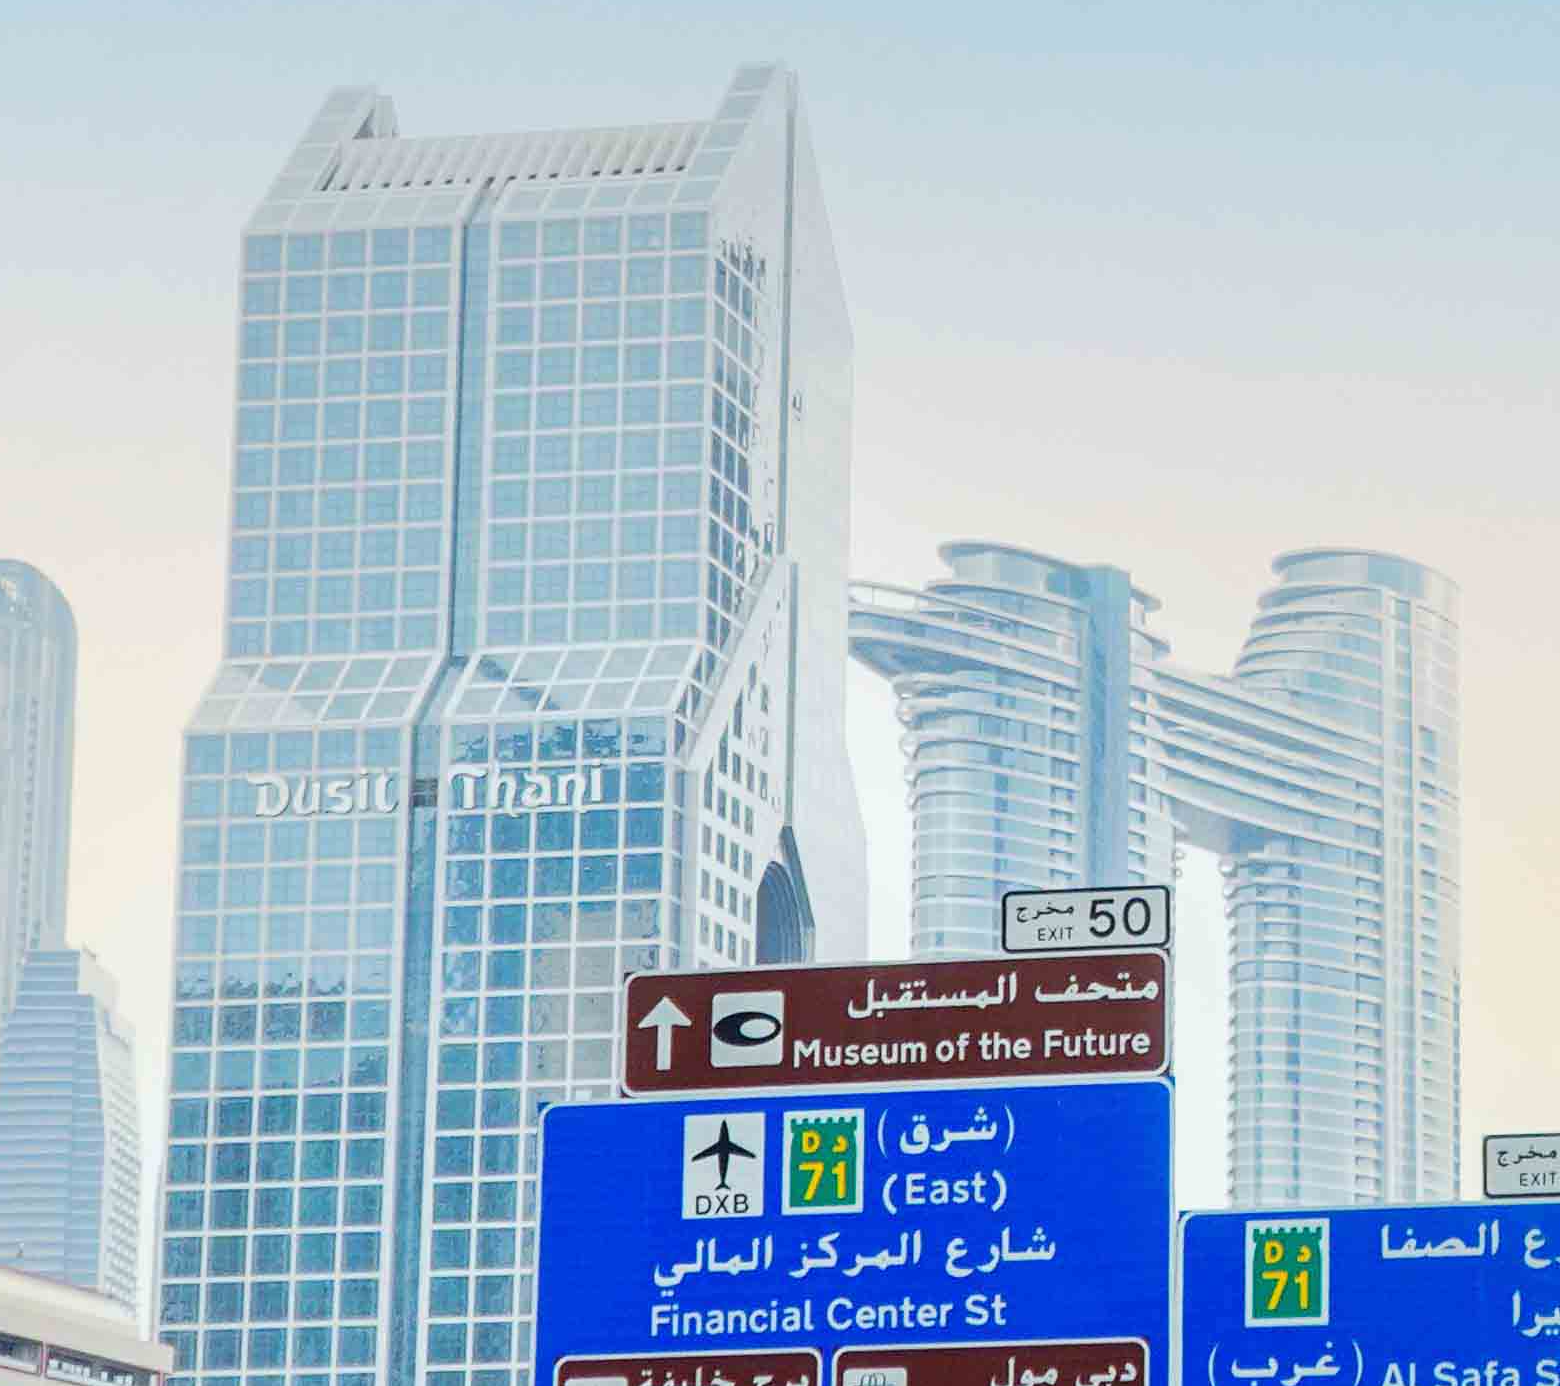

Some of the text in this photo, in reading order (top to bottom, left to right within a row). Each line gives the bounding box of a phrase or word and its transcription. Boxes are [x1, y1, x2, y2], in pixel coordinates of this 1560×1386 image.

[246, 760, 605, 817] Dusit Thani
[1015, 903, 1075, 925] مخرج
[1037, 926, 1073, 942] EXIT
[1088, 897, 1152, 938] 50
[847, 973, 1159, 1019] متحف المستقبل
[792, 1029, 1150, 1069] Museum of the Future
[801, 1132, 821, 1154] D
[1497, 1145, 1558, 1167] مخرج
[799, 1162, 848, 1203] 71
[882, 1172, 1008, 1214] (East)
[1519, 1170, 1557, 1188] EXIT
[695, 1193, 750, 1215] DXB
[1264, 1240, 1284, 1265] D
[1381, 1219, 1501, 1261] الصفا
[653, 1227, 1057, 1295] شارع المركز المالي
[1262, 1270, 1310, 1311] 71
[651, 1294, 1008, 1338] Financial Center St
